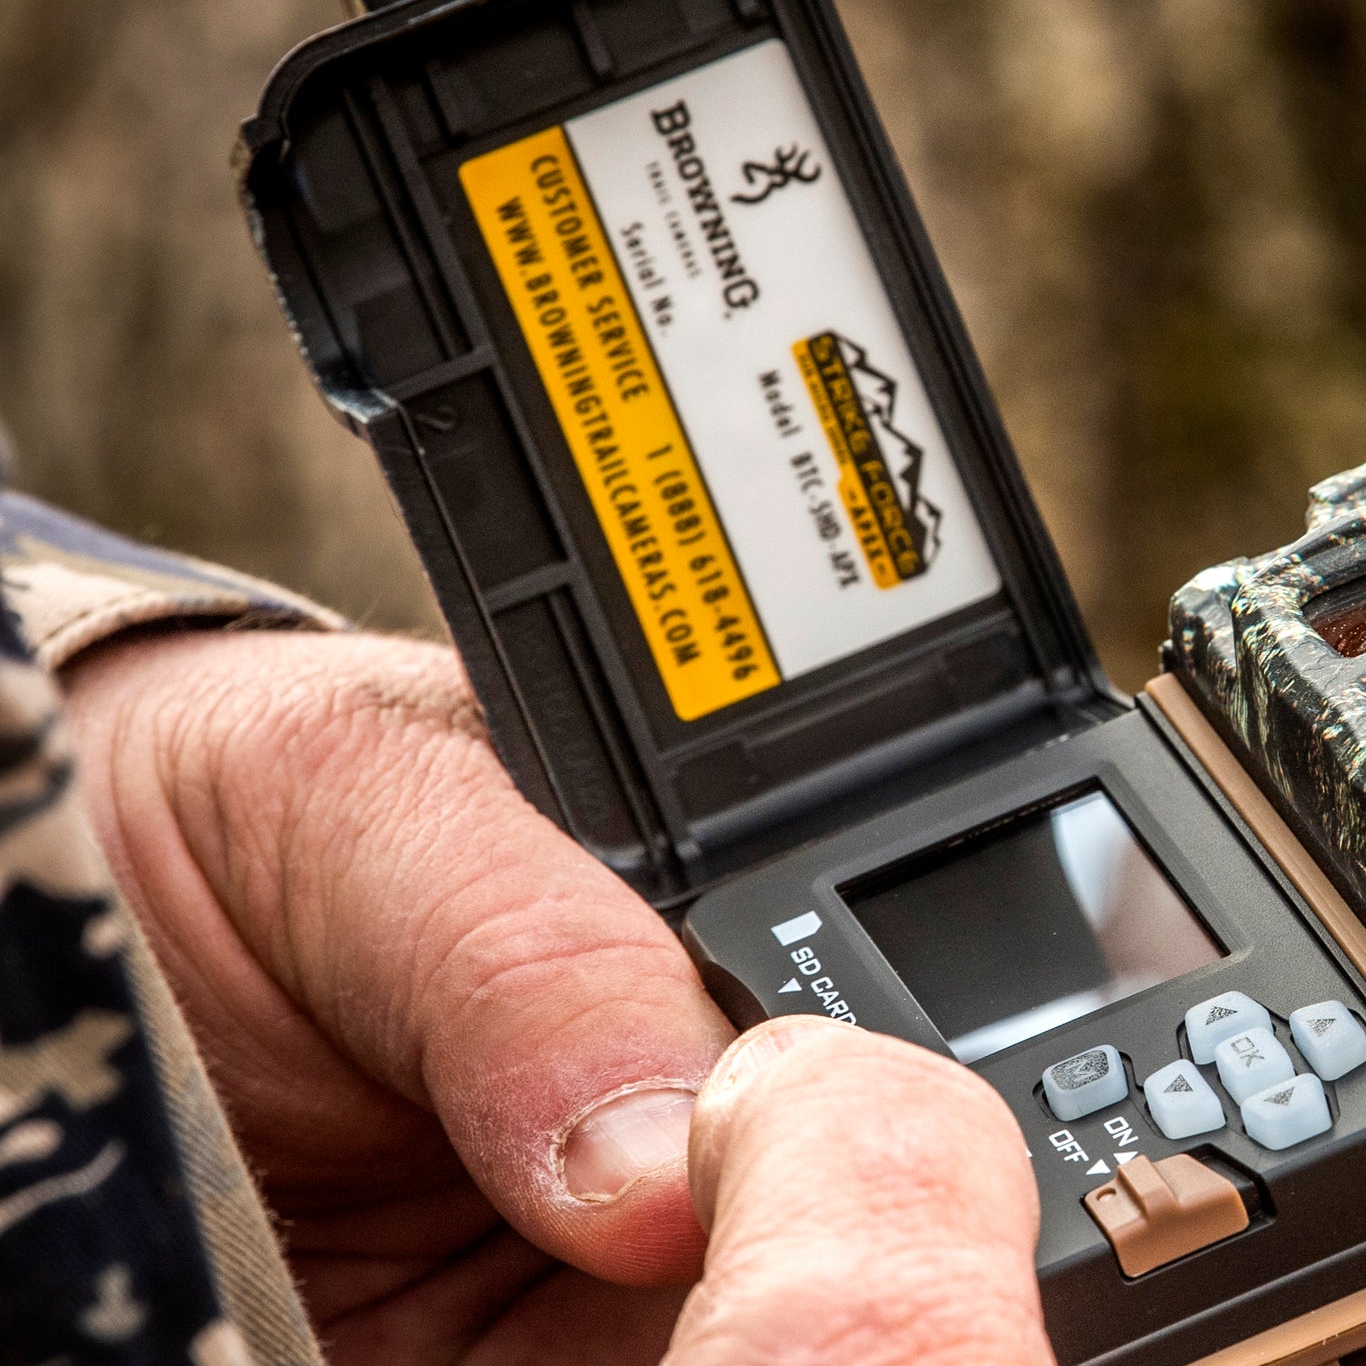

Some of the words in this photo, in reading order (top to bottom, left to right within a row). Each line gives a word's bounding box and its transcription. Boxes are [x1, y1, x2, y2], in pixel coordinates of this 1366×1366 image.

[529, 153, 605, 292] CUSTOMER
[651, 99, 759, 310] BROWNING
[620, 221, 666, 290] Serial
[585, 295, 650, 403] SERVICE
[496, 195, 703, 668] WWW.BROWNINGTRAILCAMERAS.COM
[758, 369, 802, 438] Model
[645, 443, 674, 461] 1
[809, 334, 871, 455] STRIKE
[860, 458, 920, 576] FORCE
[653, 468, 707, 547] (888)
[688, 552, 760, 681] 618-4496
[790, 946, 822, 976] SD
[1230, 1036, 1265, 1068] OK
[1048, 1129, 1090, 1162] OFF
[1103, 1116, 1139, 1147] ON
